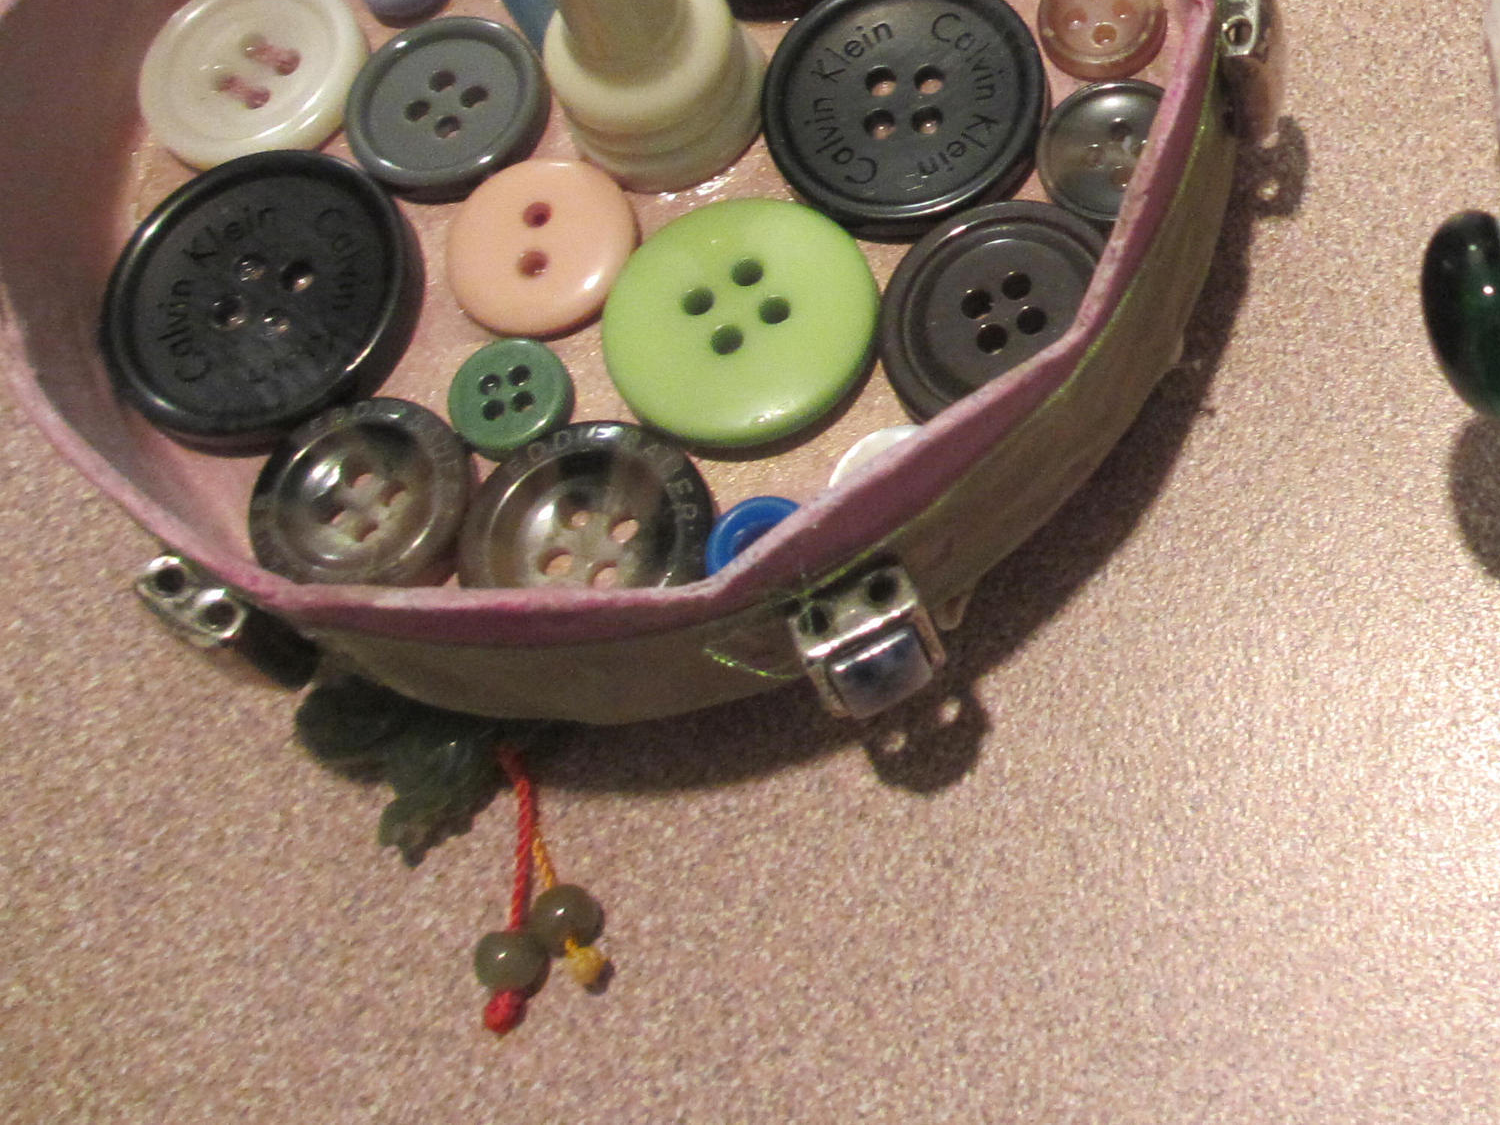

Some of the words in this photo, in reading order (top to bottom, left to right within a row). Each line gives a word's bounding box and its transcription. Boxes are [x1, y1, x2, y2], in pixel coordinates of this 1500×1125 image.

[811, 21, 893, 84] Klein
[932, 12, 1004, 101] Calvin
[805, 97, 878, 185] Calvin
[917, 113, 998, 178] Klein
[157, 278, 213, 384] Calvin
